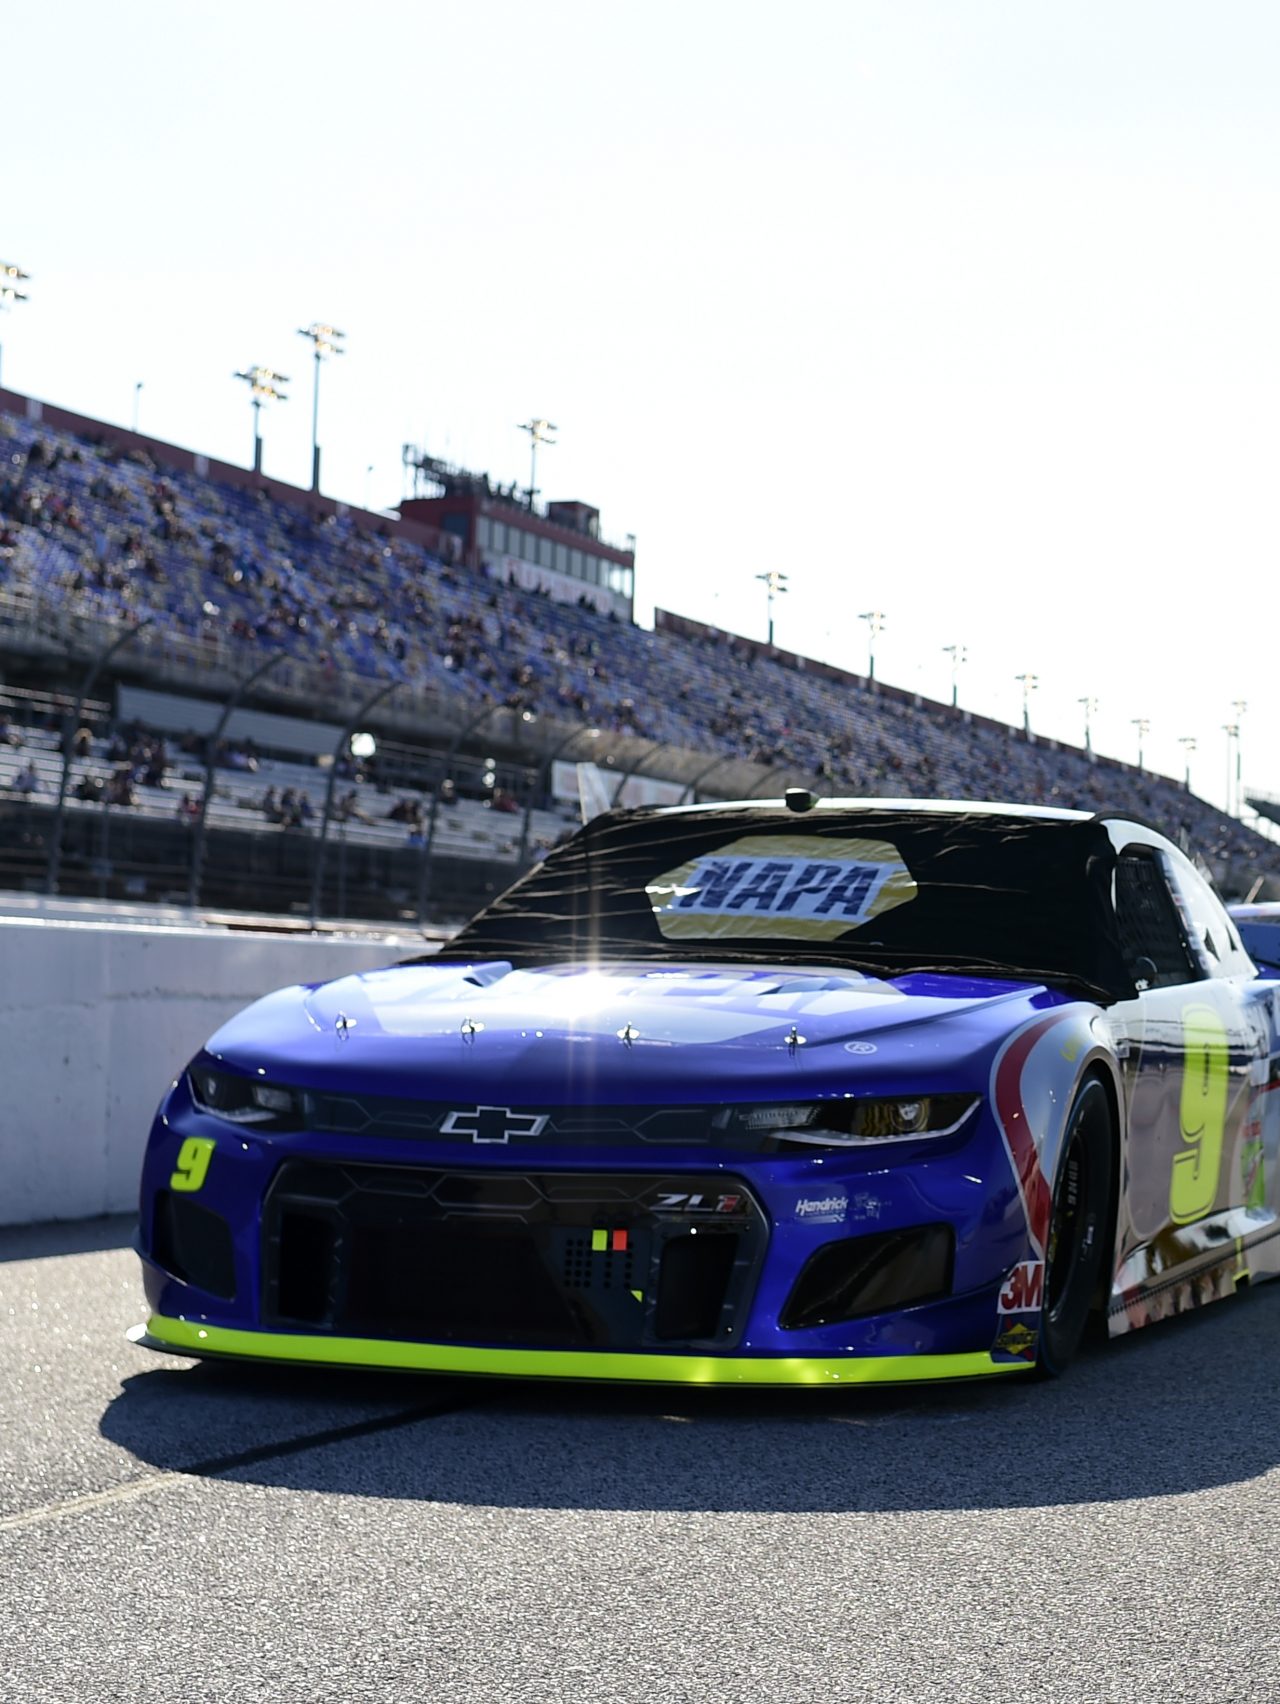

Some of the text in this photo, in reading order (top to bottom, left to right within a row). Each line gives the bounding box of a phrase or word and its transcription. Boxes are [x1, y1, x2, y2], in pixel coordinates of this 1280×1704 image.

[677, 860, 880, 916] NAPA
[1169, 1003, 1230, 1225] 9
[169, 1136, 216, 1192] 9
[649, 1193, 740, 1213] ZL1
[795, 1196, 848, 1216] Hendrick
[1001, 1264, 1043, 1311] 3M
